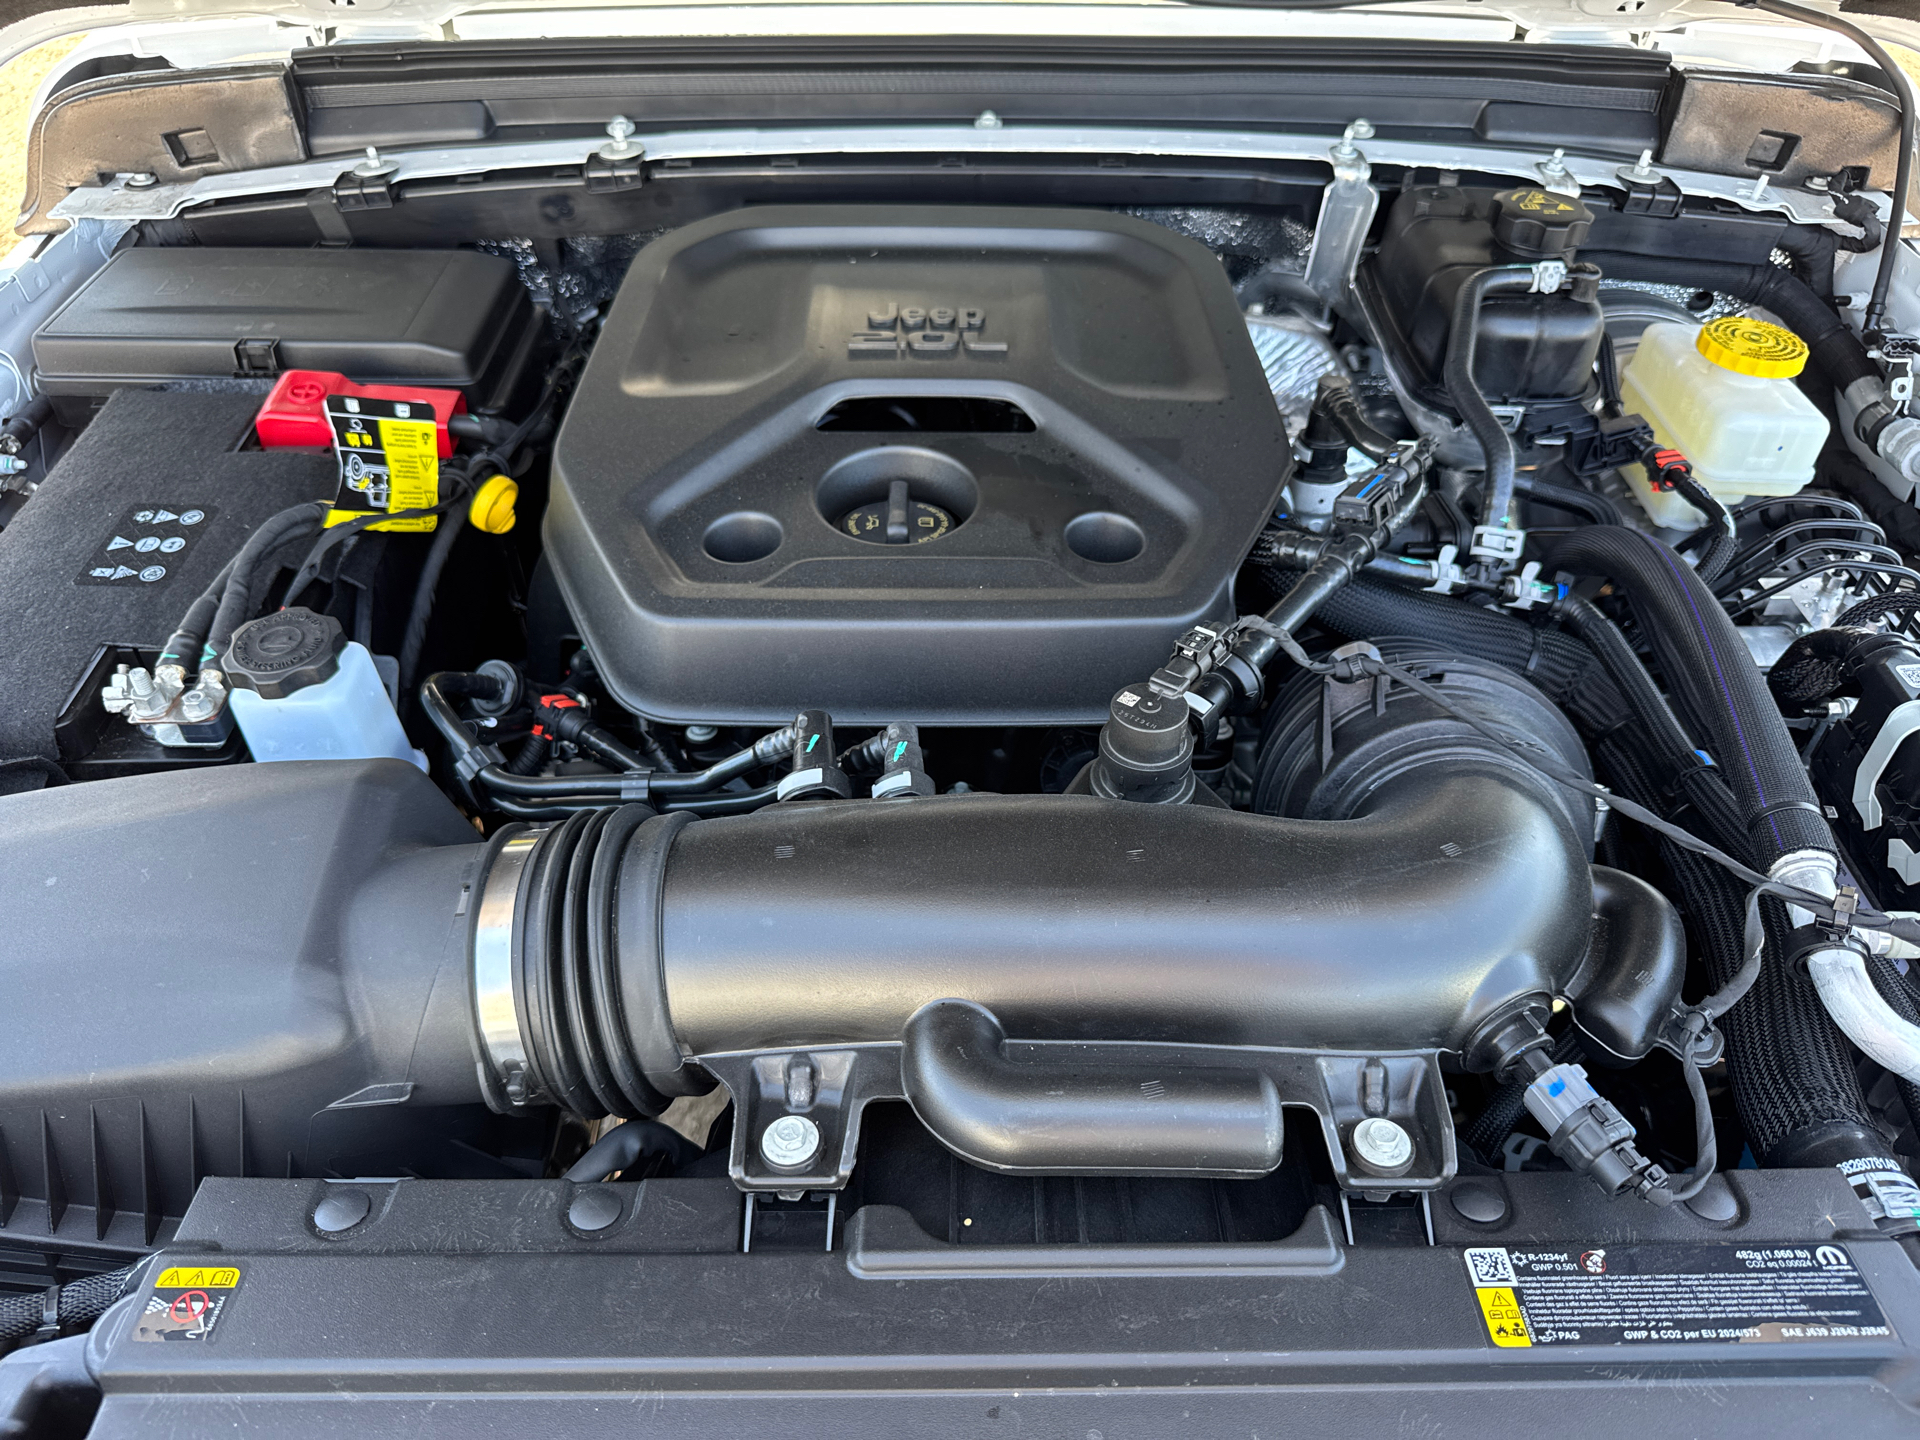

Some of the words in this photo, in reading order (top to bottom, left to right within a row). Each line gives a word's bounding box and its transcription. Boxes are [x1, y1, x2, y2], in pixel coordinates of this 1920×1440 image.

[868, 302, 987, 329] Jeep
[848, 331, 1008, 352] 2.0L
[1528, 1253, 1568, 1262] R-1234yf
[1555, 1263, 1578, 1271] 0.501
[1746, 1260, 1766, 1268] CO2
[1767, 1261, 1779, 1269] eq
[1558, 1331, 1580, 1340] PAG
[1623, 1331, 1648, 1340] GWP
[1650, 1330, 1659, 1339] &
[1660, 1330, 1682, 1339] CO2
[1683, 1331, 1700, 1340] per
[1701, 1330, 1717, 1338] EU
[1717, 1328, 1761, 1338] 2024/573
[1781, 1327, 1804, 1337] SAE
[1805, 1327, 1829, 1337] J639
